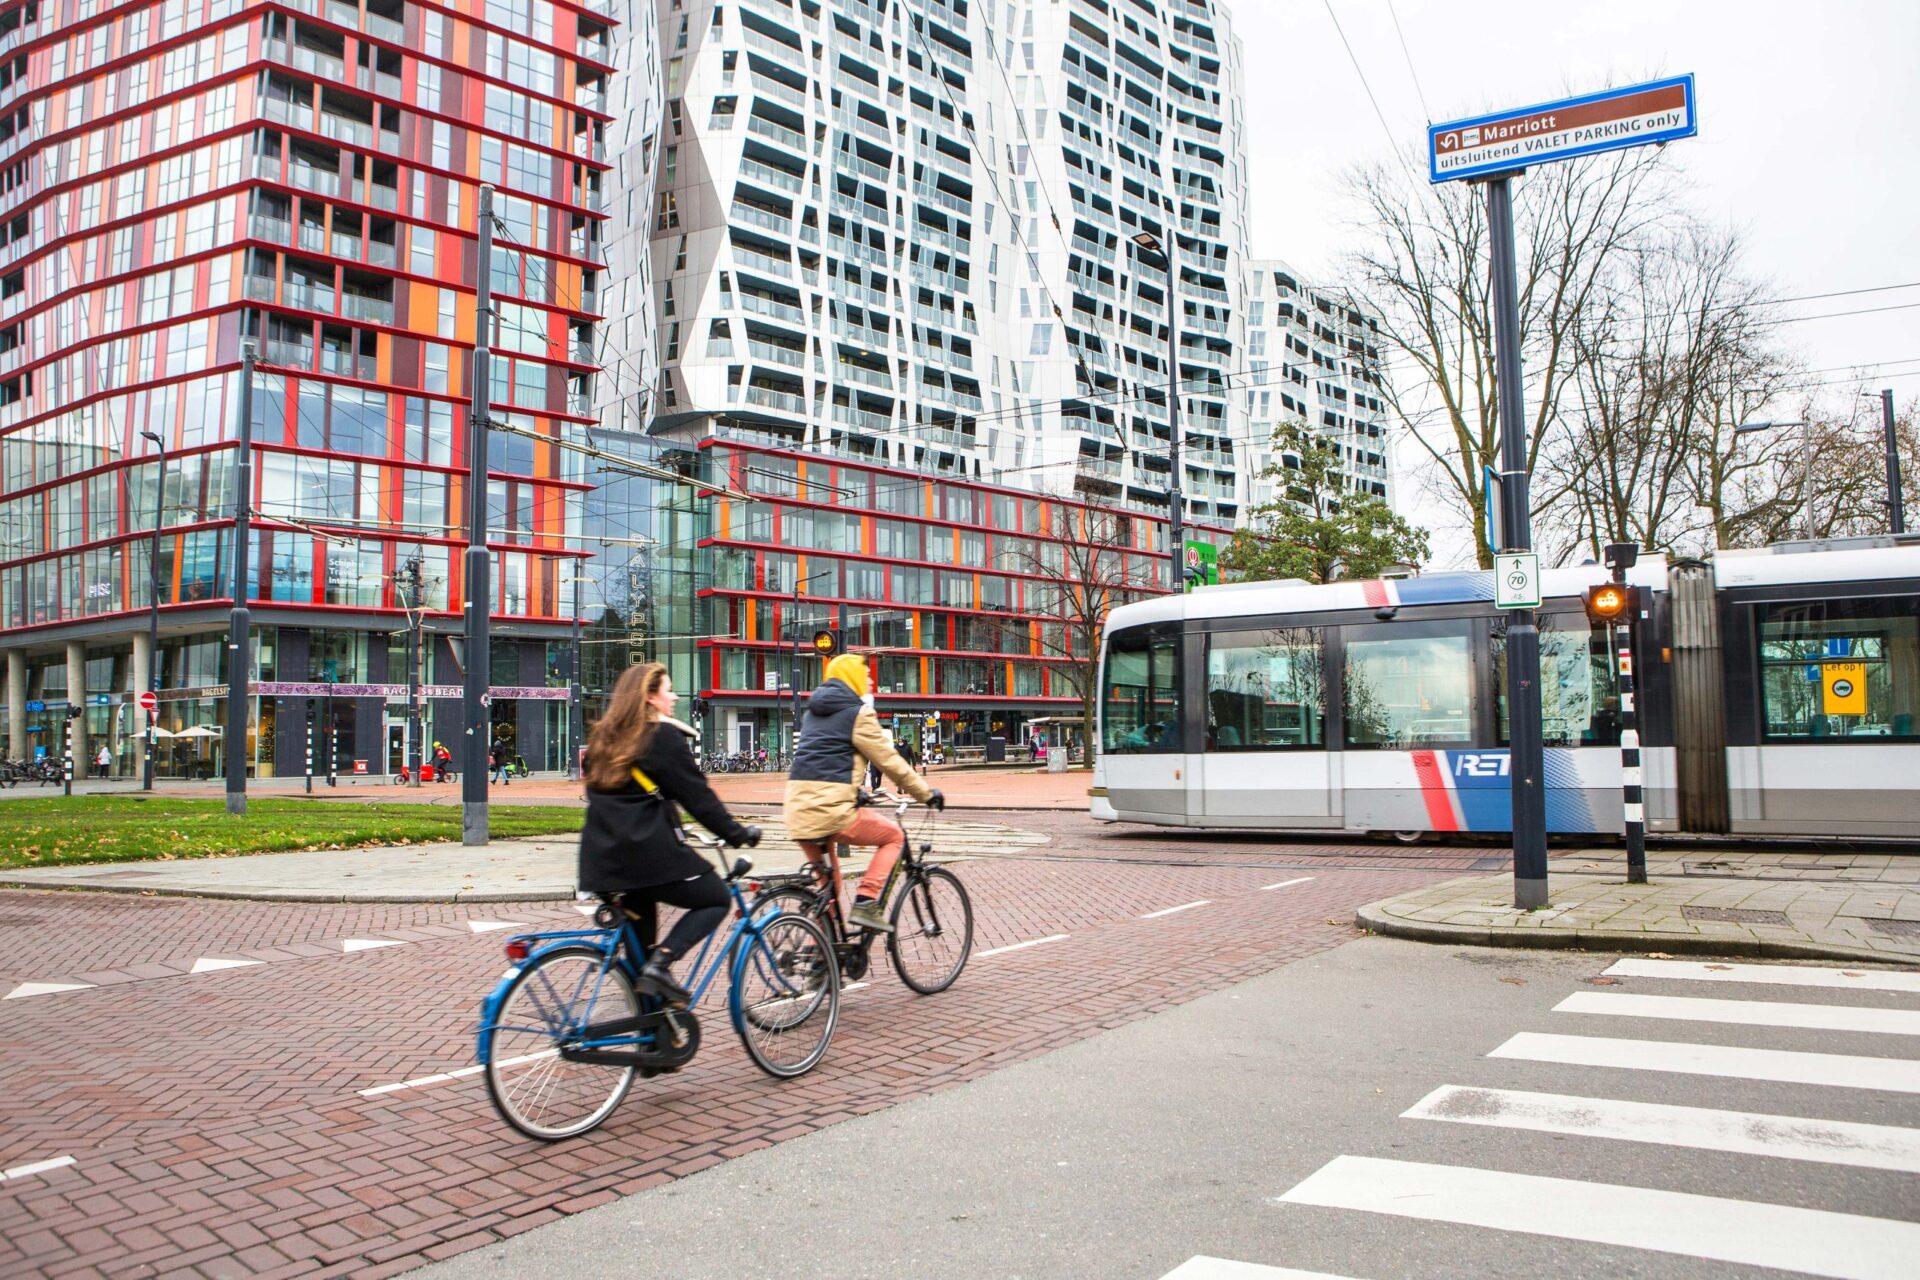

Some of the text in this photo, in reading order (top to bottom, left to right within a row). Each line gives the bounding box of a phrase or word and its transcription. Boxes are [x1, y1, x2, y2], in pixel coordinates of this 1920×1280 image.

[1484, 115, 1556, 141] Marriott
[1441, 112, 1681, 168] uitsluitend VALET PARKING only
[1511, 576, 1524, 586] 70
[1825, 663, 1841, 671] Let
[1844, 663, 1855, 672] op
[1455, 754, 1511, 777] RET
